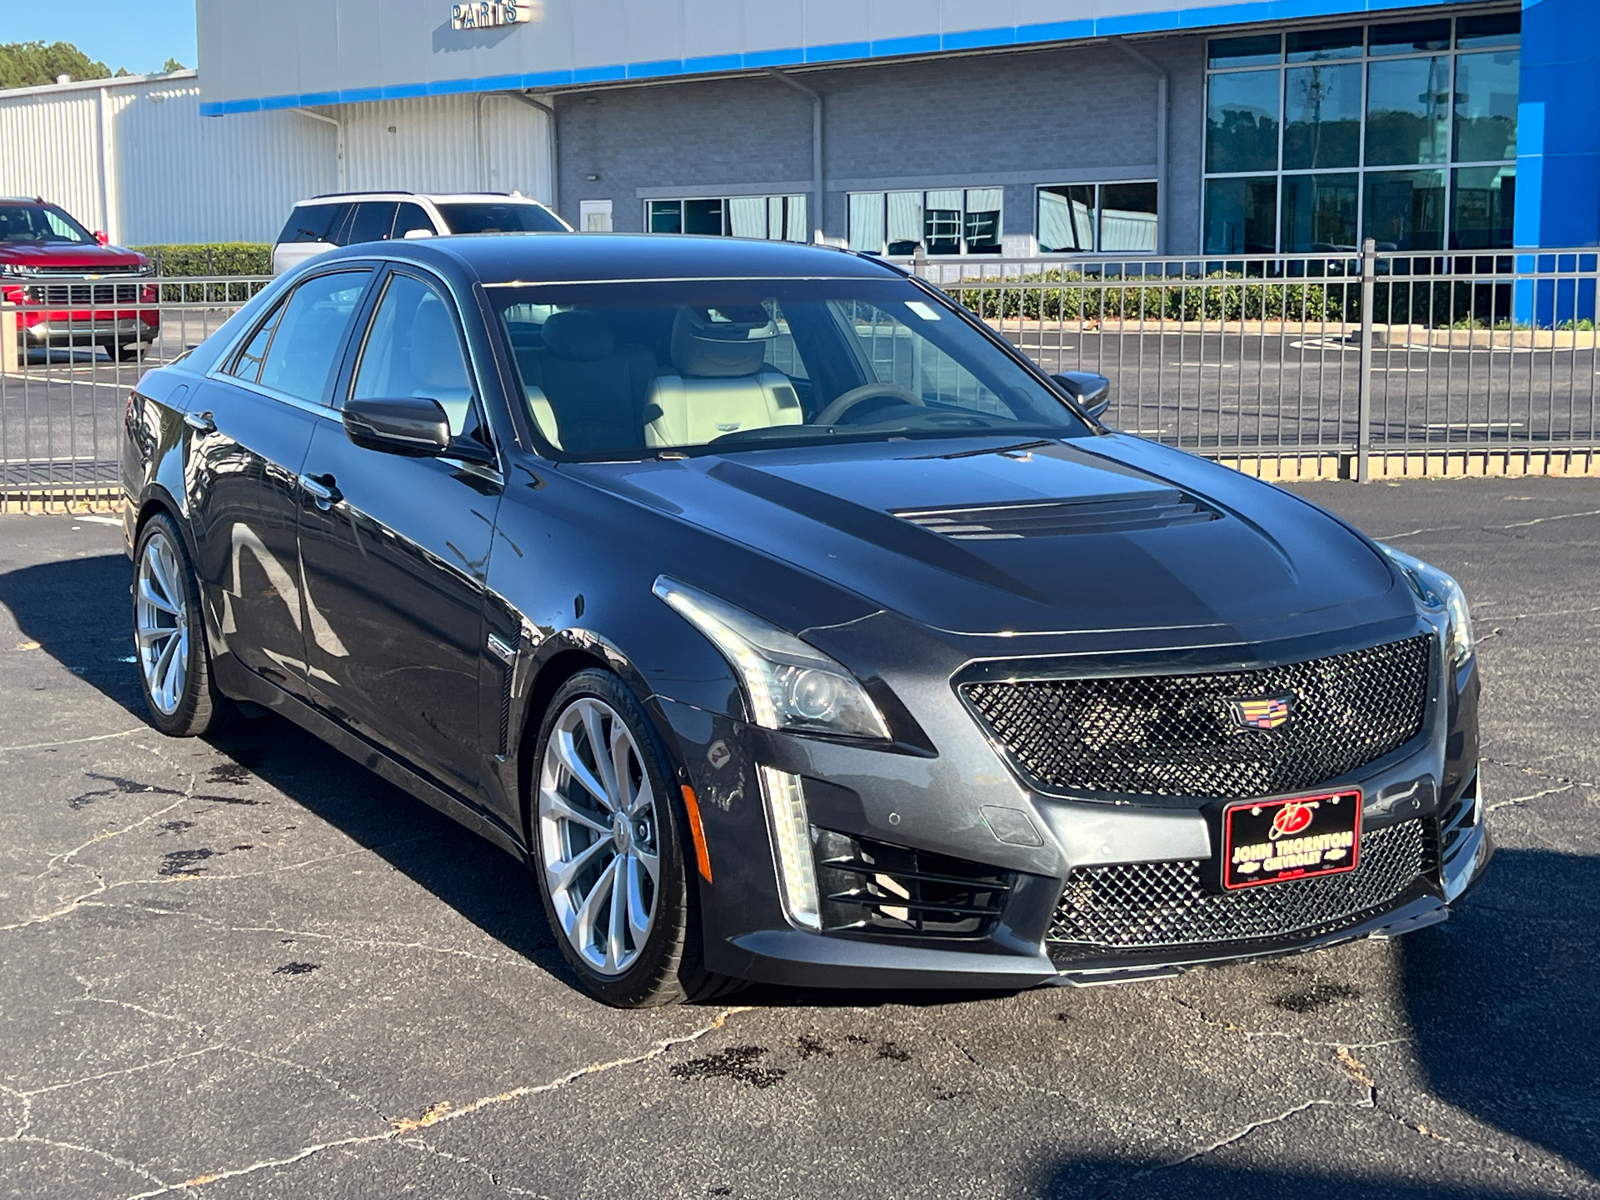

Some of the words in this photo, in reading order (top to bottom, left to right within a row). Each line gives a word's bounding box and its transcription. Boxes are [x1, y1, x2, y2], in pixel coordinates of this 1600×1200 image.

[450, 0, 521, 30] PARTS
[1232, 842, 1273, 864] JOHN
[1275, 831, 1353, 856] THORNTON
[1263, 850, 1322, 871] CHEVROLET
